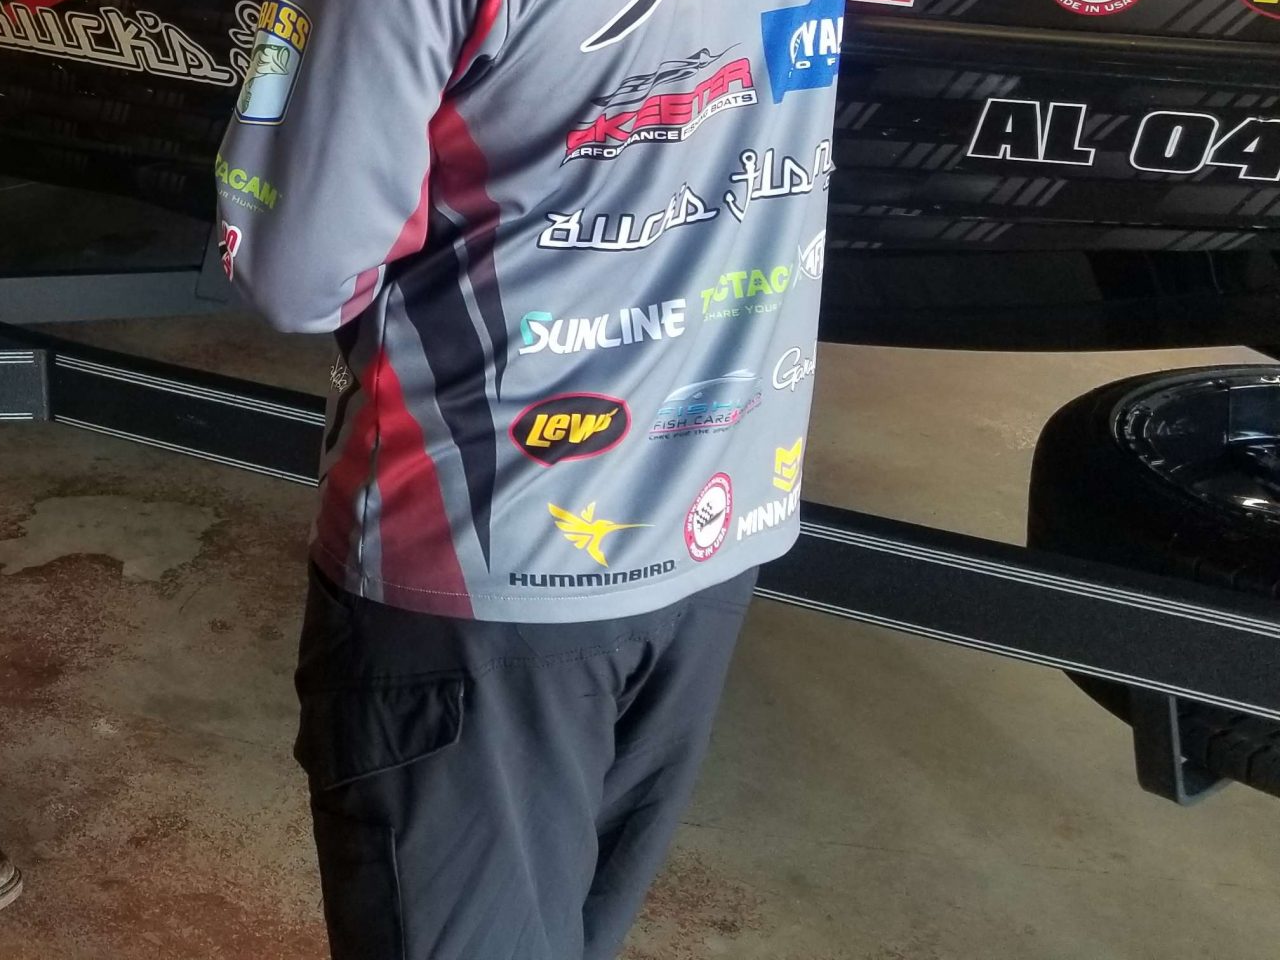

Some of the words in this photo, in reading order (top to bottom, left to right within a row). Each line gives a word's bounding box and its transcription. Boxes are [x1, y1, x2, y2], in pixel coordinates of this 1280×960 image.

[1085, 5, 1100, 13] IN
[566, 57, 754, 152] SKEETER
[709, 92, 756, 116] BOATS
[967, 97, 1096, 166] AL
[519, 298, 687, 355] SUNLINE
[654, 419, 687, 430] FISH
[694, 414, 730, 425] CARE
[736, 496, 787, 541] MINN
[705, 548, 714, 557] IN
[509, 559, 676, 588] HUMMINBIRD
